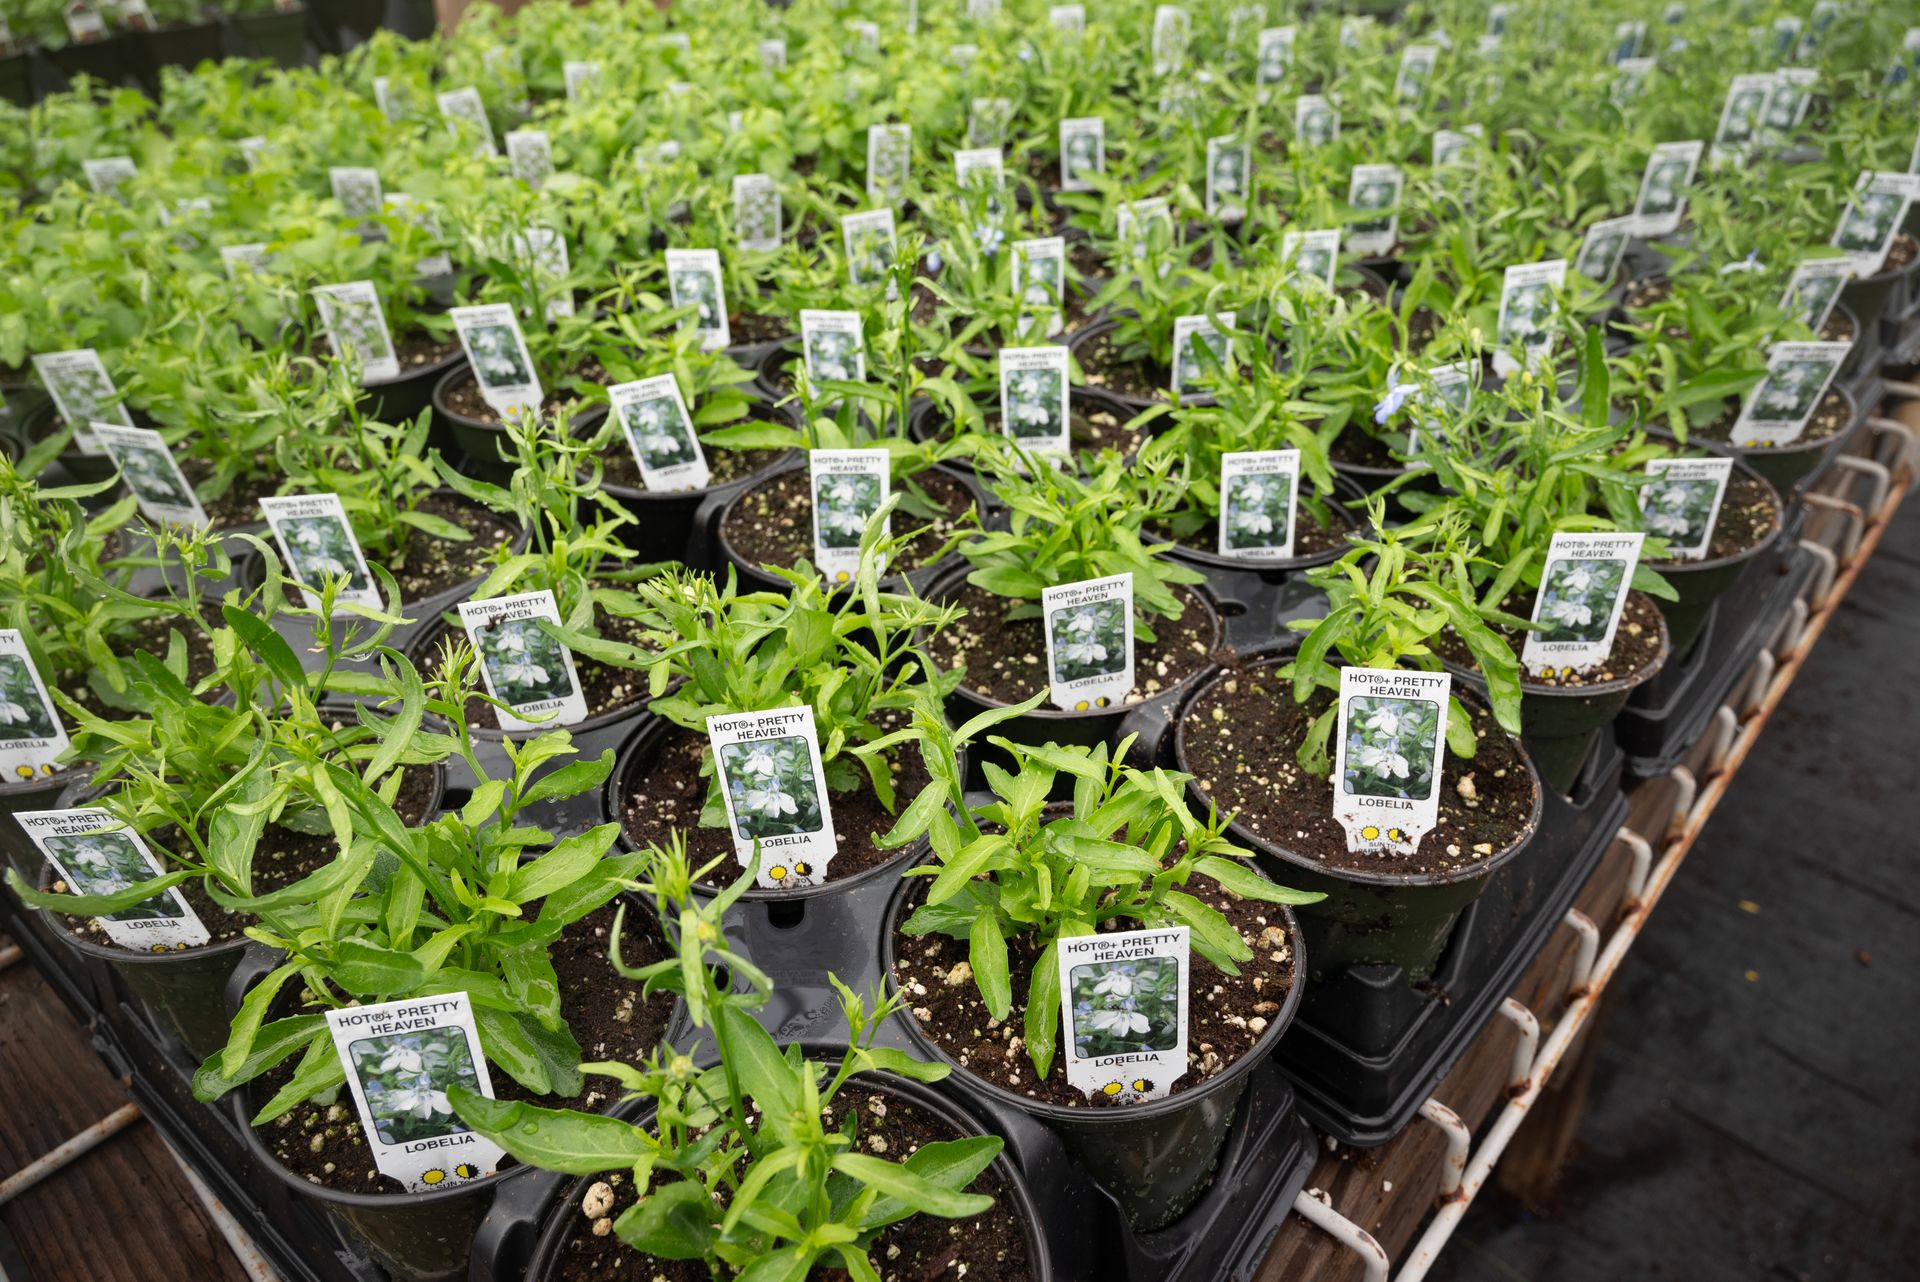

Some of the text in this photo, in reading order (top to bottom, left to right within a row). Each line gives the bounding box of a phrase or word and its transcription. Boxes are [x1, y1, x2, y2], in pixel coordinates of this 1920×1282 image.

[286, 508, 324, 516] HEAVEN
[1593, 540, 1635, 549] PRETTY
[1571, 550, 1614, 558] HEAVEN
[1085, 580, 1126, 594] PRETTY
[505, 597, 547, 610] PRETTY
[1067, 592, 1109, 607] HEAVEN
[1543, 644, 1589, 652] LOBELIA
[1069, 675, 1114, 690] LOBELIA
[1394, 676, 1444, 688] PRETTY
[1369, 685, 1421, 697] HEAVEN
[516, 700, 565, 714] LOBELIA
[757, 713, 805, 728] PRETTY
[737, 726, 787, 741] HEAVEN
[1358, 797, 1414, 811] LOBELIA
[760, 835, 812, 849] OBELIA
[126, 919, 181, 931] LOBELIA
[1122, 933, 1181, 948] PRETTY
[1094, 946, 1155, 961] HEAVEN
[397, 1000, 459, 1019] PRETTY
[371, 1016, 437, 1035] HEAVEN
[1095, 1053, 1160, 1067] LOBELIA
[405, 1134, 476, 1154] LOBELIA
